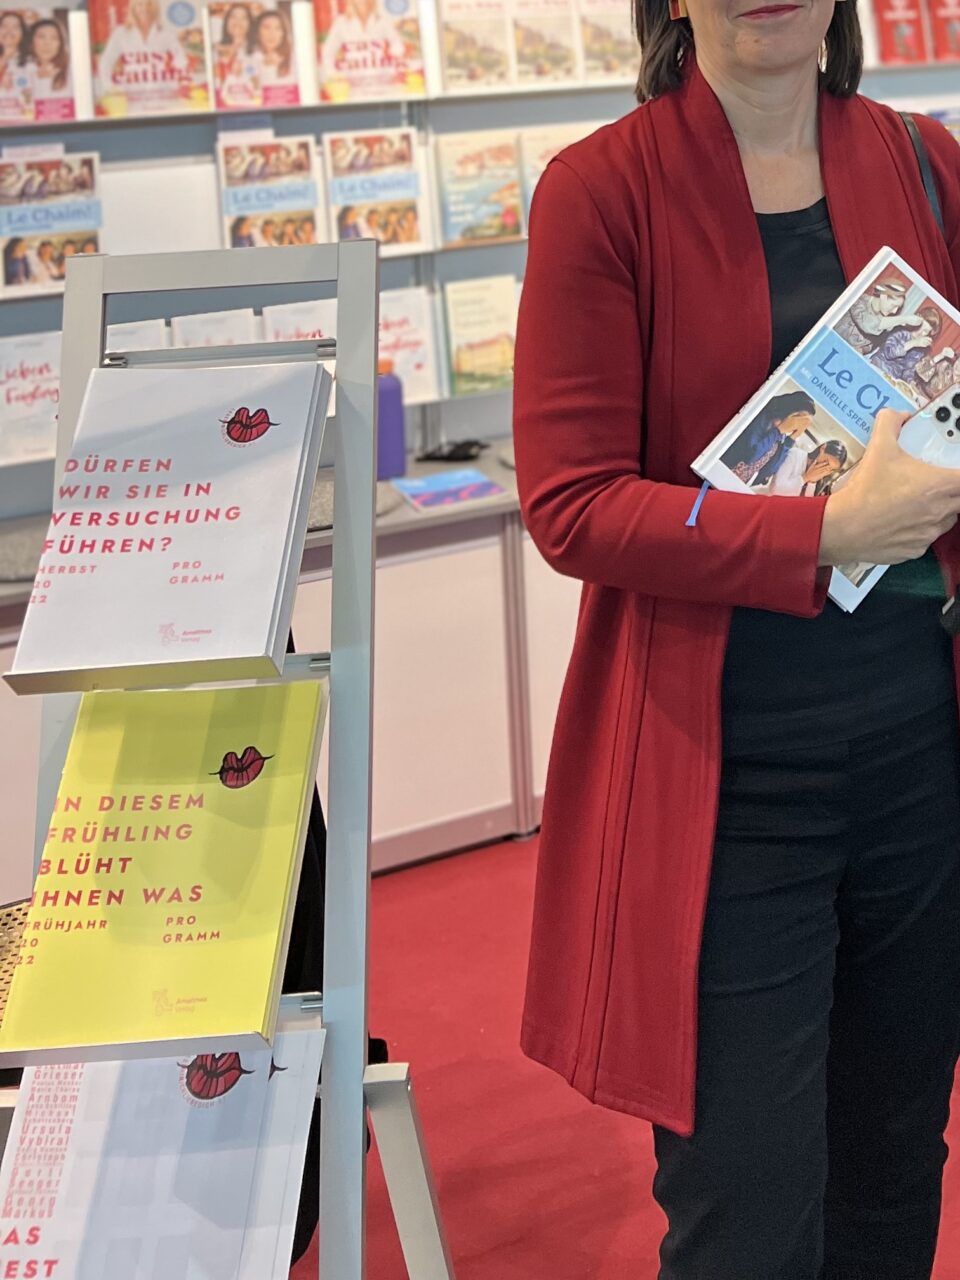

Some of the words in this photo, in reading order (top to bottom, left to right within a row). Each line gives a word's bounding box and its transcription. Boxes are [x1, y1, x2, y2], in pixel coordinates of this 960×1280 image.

[817, 347, 854, 390] Le
[811, 376, 847, 412] DANIELLE
[846, 409, 871, 434] SPERA
[64, 454, 172, 473] DÜRFEN
[57, 484, 111, 500] WIR
[125, 483, 169, 499] SIE
[183, 482, 212, 497] IN
[51, 506, 242, 527] VERSUCHUNG
[40, 534, 173, 555] FÜHREN?
[172, 560, 202, 571] PRO
[168, 573, 225, 585] GRAMM
[98, 793, 205, 812] DIESEM
[38, 852, 133, 875] BLÜHT
[30, 889, 125, 908] IHNEN
[142, 885, 203, 905] WAS
[166, 915, 197, 927] PRO
[162, 930, 221, 944] GRAMM
[0, 1225, 41, 1246] AS
[0, 1258, 60, 1279] EST
